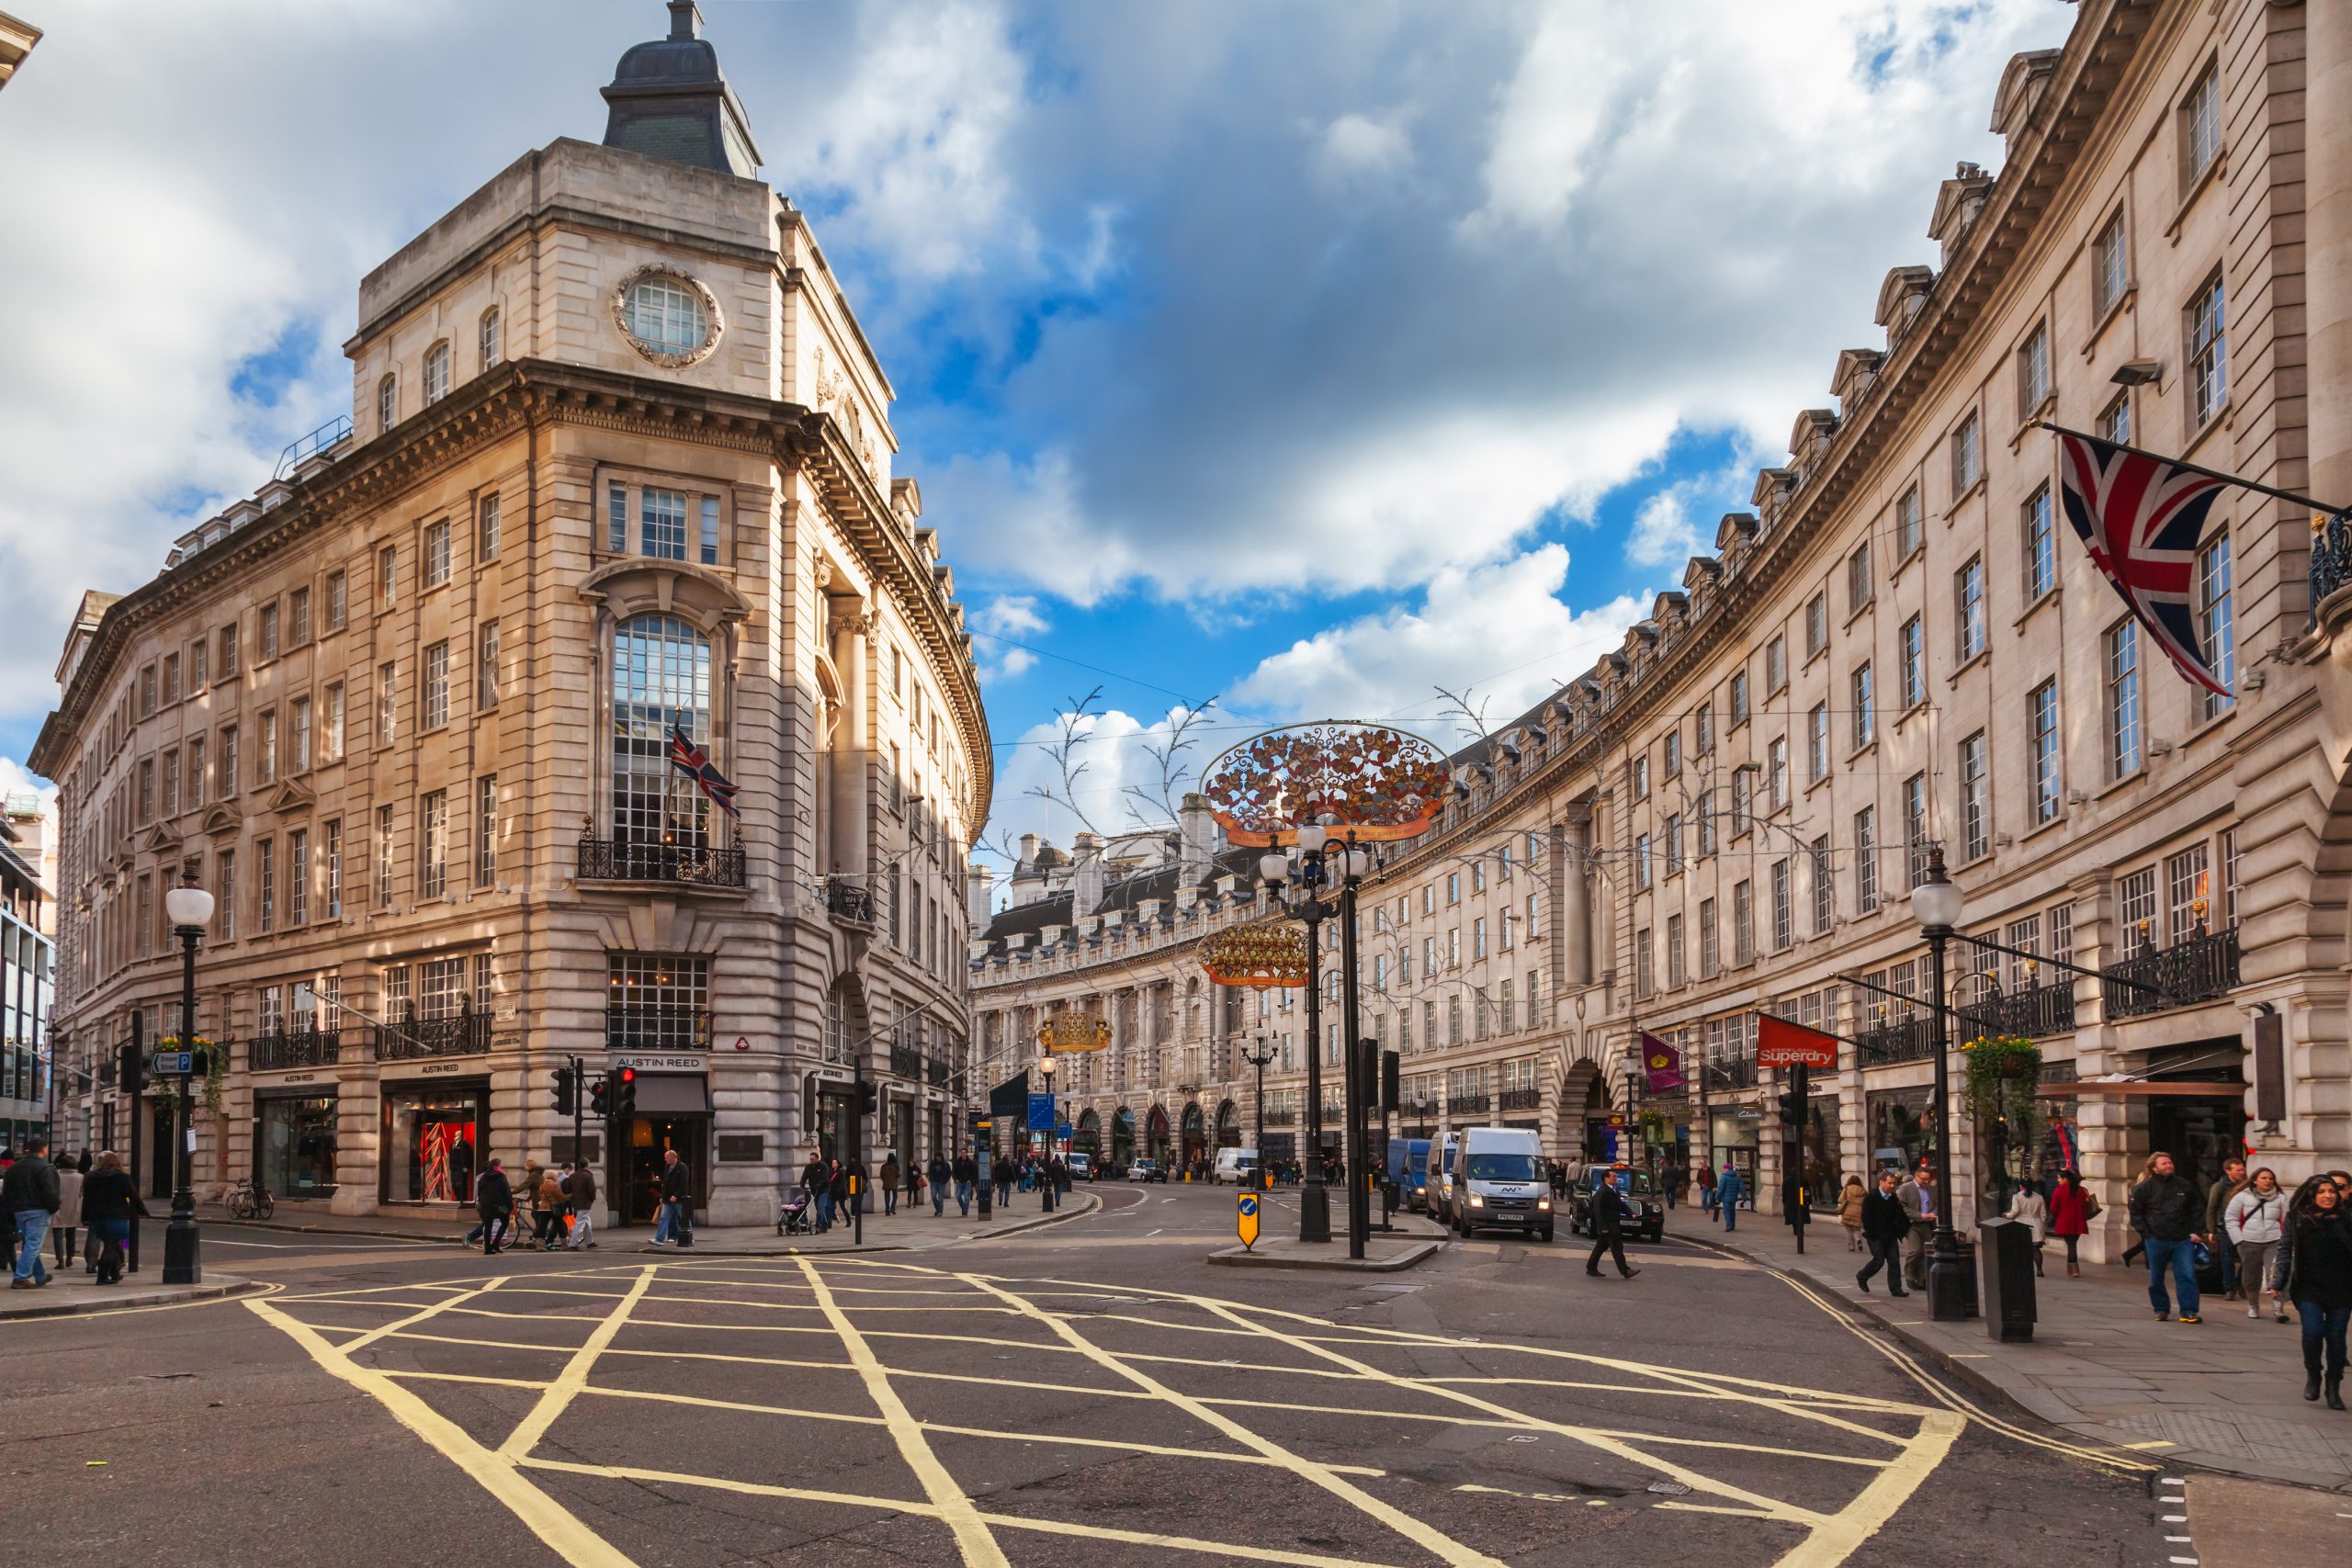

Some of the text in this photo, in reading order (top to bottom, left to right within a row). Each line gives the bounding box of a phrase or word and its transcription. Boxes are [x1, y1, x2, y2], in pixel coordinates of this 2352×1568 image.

[1759, 1050, 1832, 1065] Superdry
[617, 1058, 700, 1066] AUSTIN REED
[443, 1064, 458, 1072] REED
